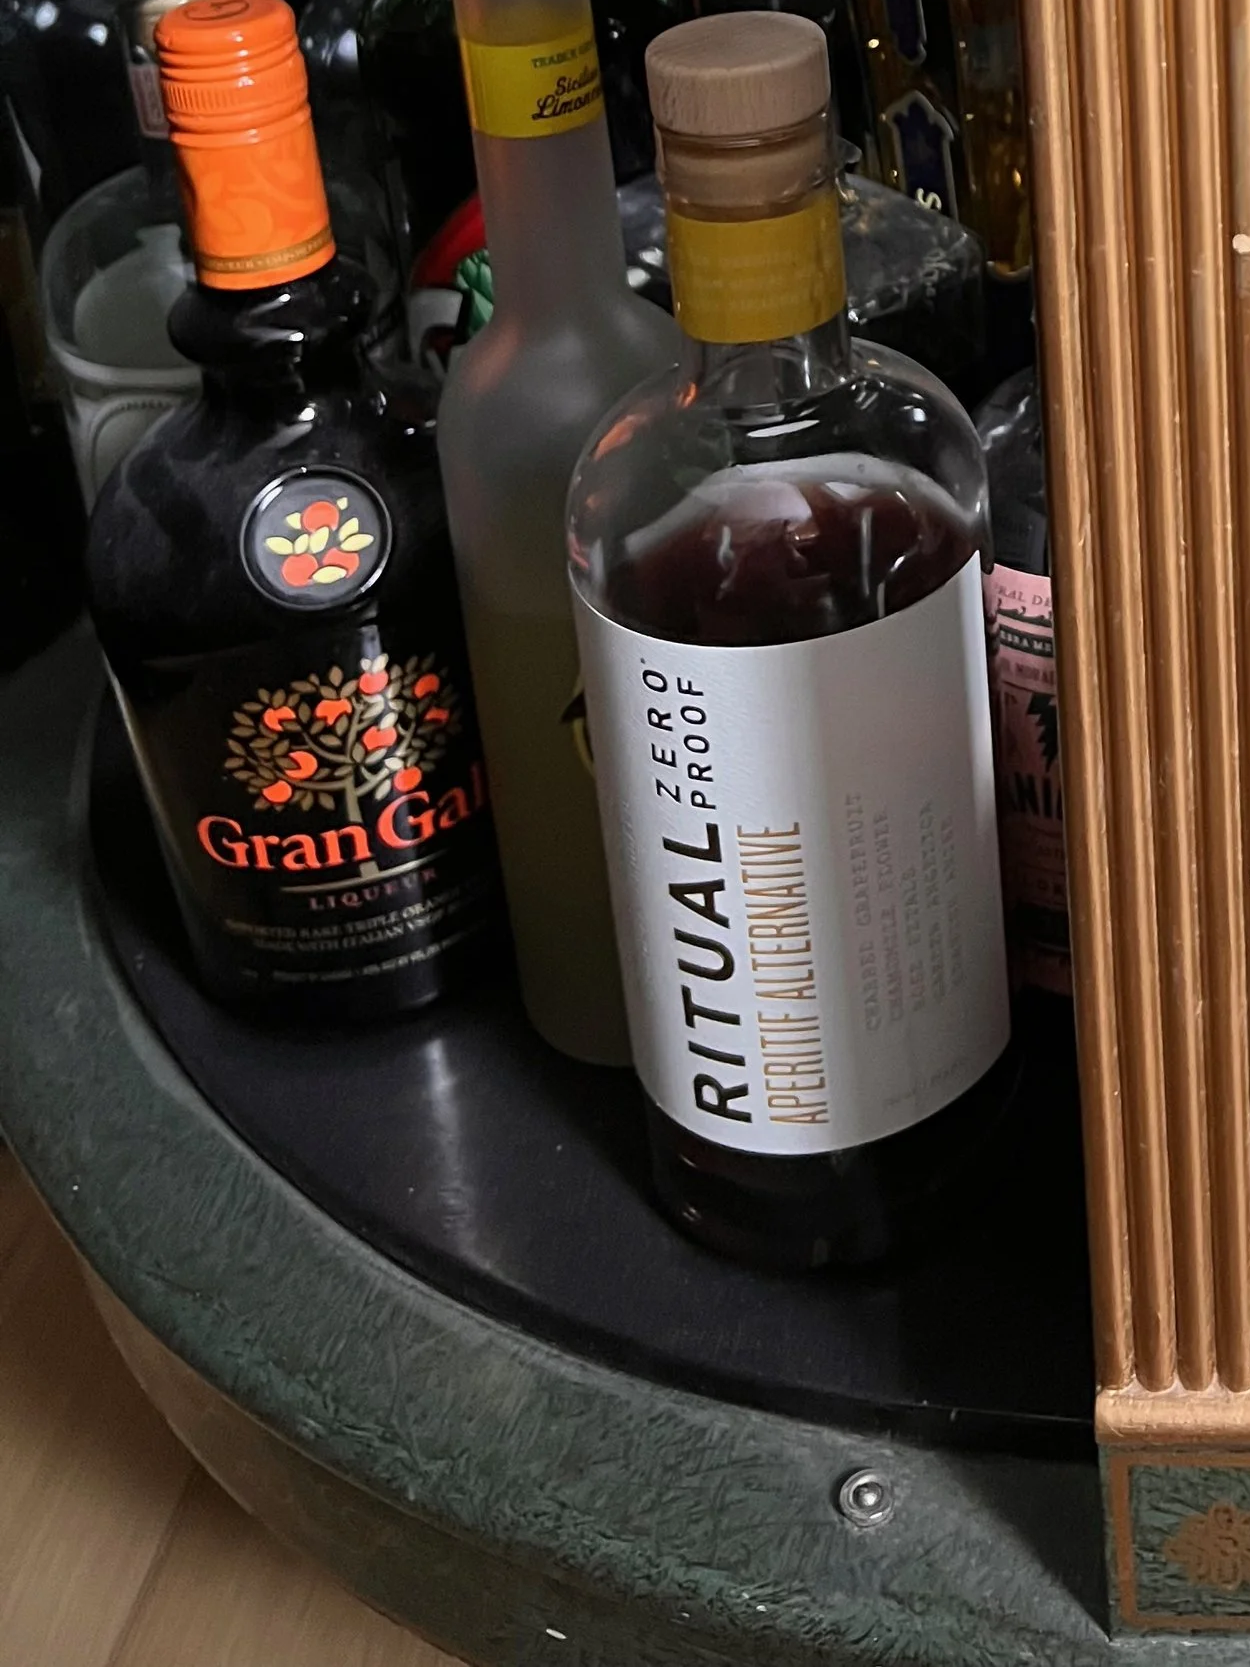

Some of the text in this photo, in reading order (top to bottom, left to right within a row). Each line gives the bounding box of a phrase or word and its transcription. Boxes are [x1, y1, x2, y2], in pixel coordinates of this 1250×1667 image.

[641, 668, 682, 804] ZERO
[676, 676, 717, 811] PROOF
[196, 760, 486, 871] Gran Gal
[844, 792, 872, 927] GRAPEFRUIT
[307, 866, 439, 912] LIQUEUR
[661, 821, 754, 1124] RITUAL
[736, 820, 830, 1125] APERITIF ALTERNATIVE
